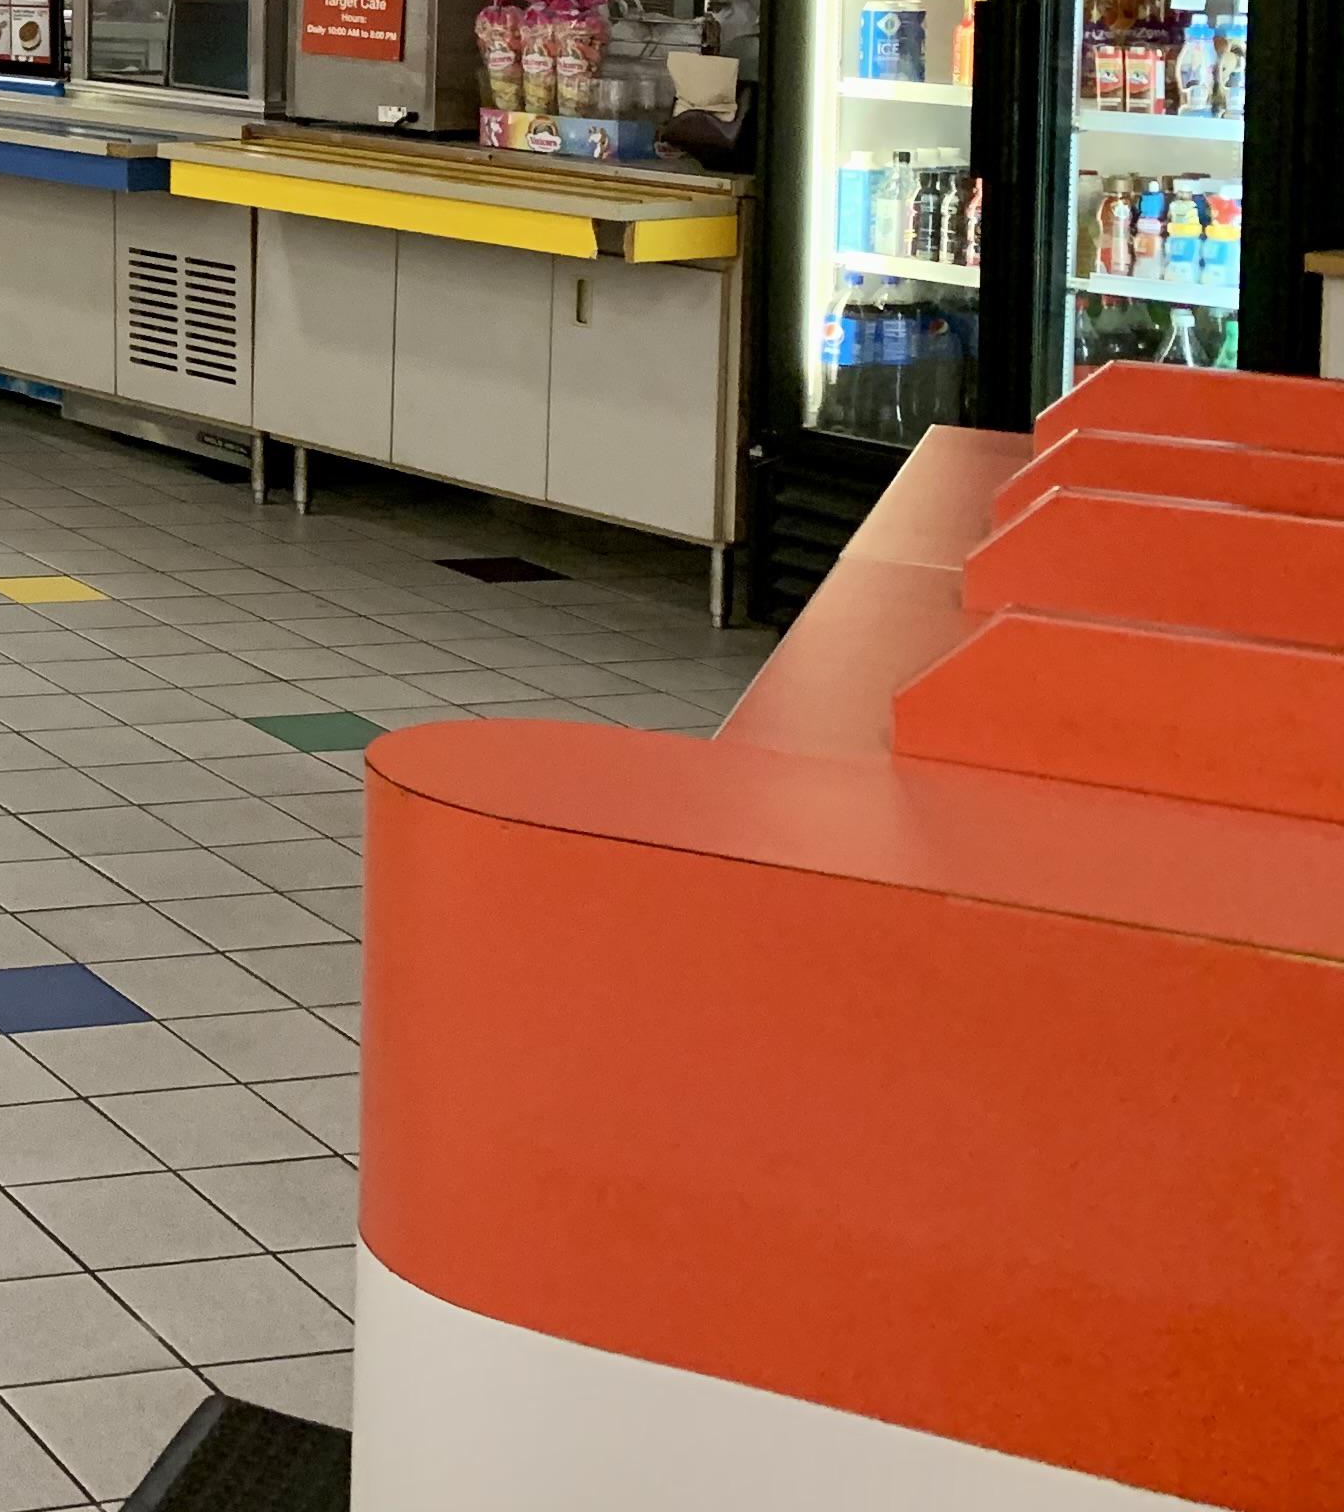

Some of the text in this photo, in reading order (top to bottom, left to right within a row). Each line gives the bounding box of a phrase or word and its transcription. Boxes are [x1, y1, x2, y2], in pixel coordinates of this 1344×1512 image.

[341, 13, 367, 23] Hours:
[307, 24, 327, 35] Daily
[328, 27, 347, 36] 10:00
[347, 29, 360, 37] AM
[361, 30, 369, 38] to
[877, 42, 900, 56] ICE
